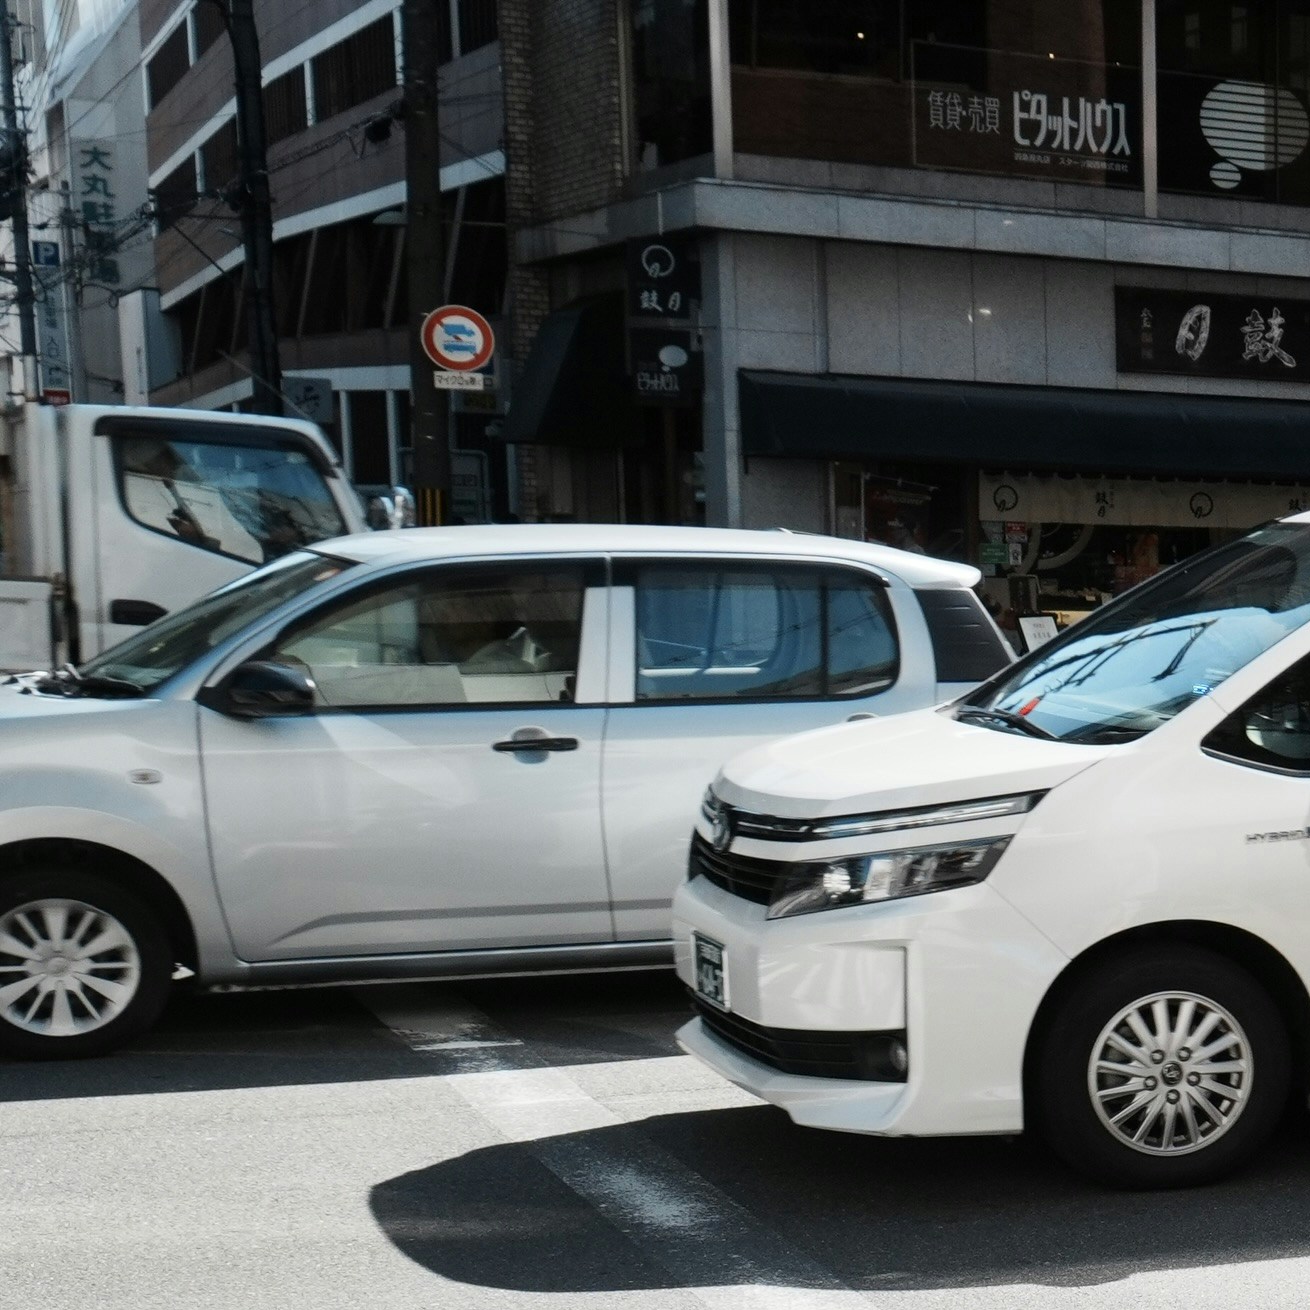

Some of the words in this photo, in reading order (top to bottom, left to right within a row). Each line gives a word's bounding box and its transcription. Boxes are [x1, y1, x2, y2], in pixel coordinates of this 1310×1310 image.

[1012, 90, 1132, 157] ピタットハウス
